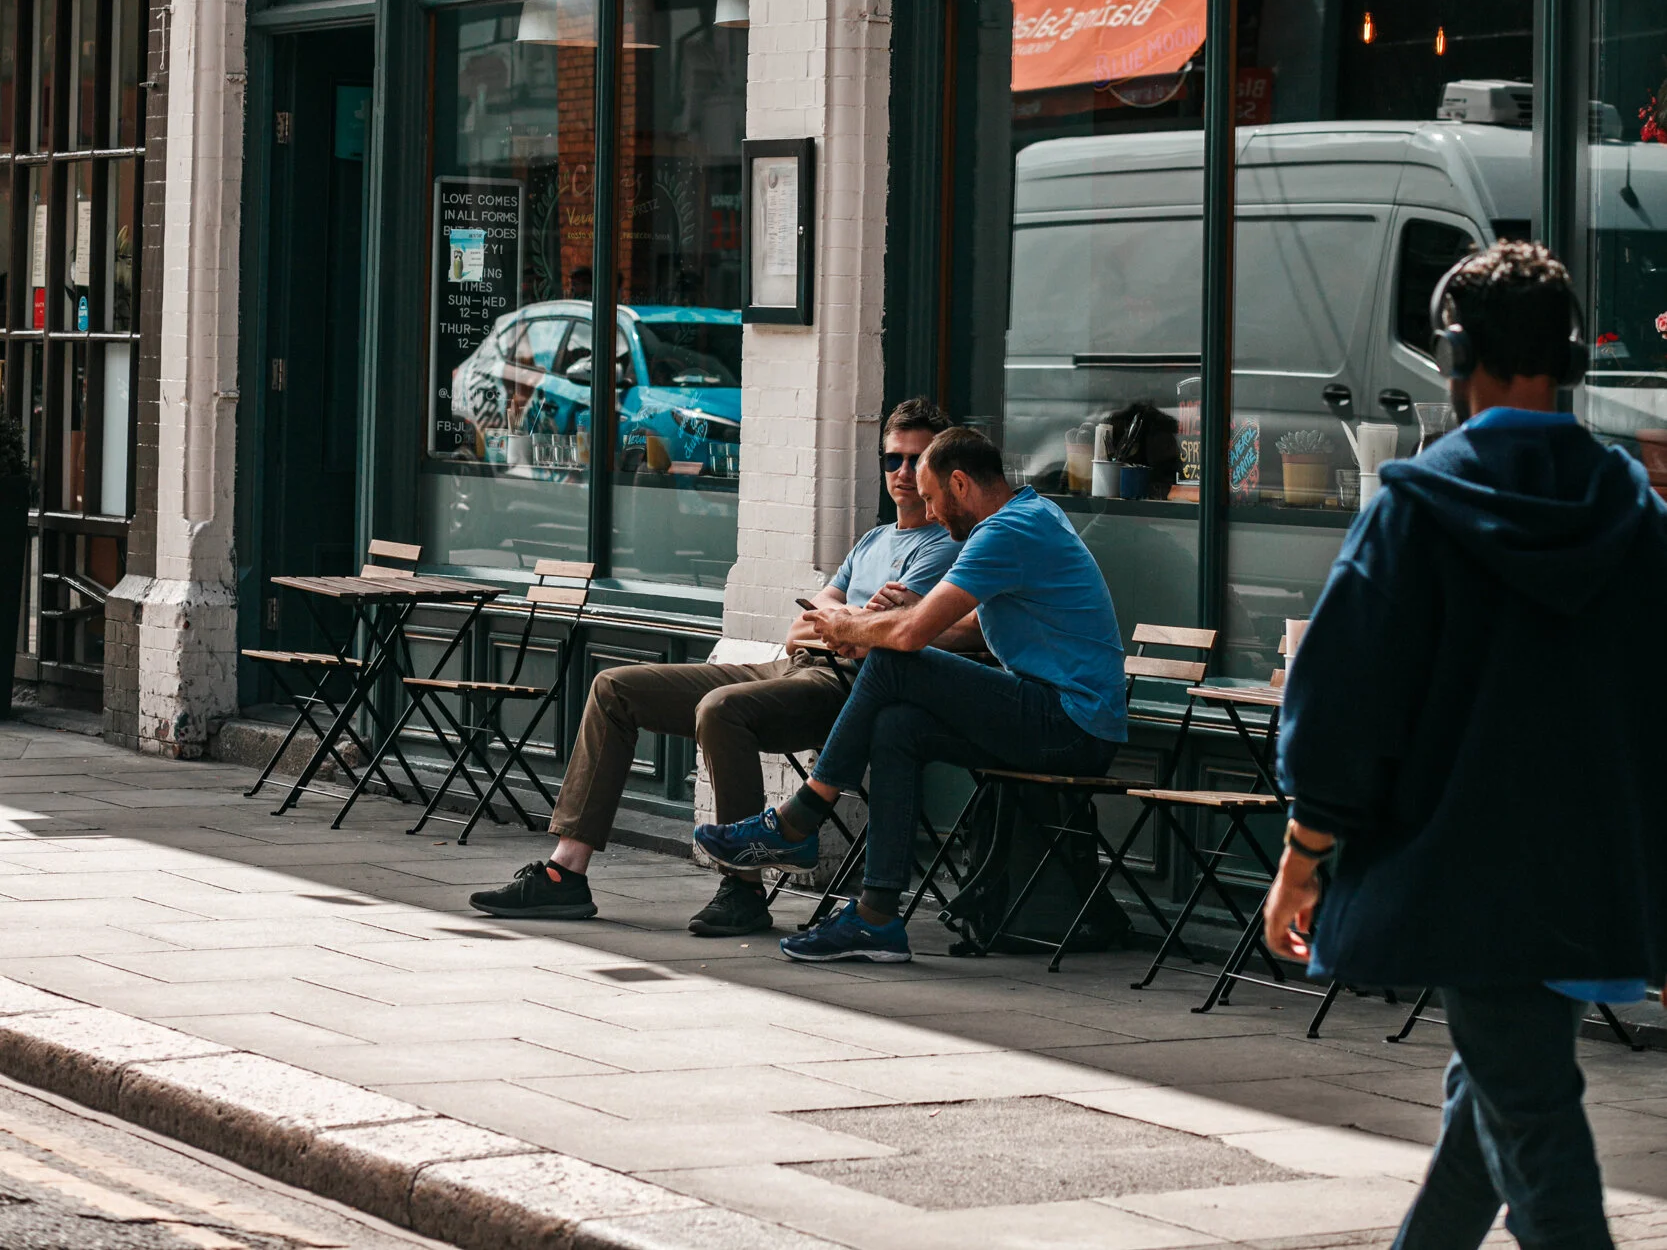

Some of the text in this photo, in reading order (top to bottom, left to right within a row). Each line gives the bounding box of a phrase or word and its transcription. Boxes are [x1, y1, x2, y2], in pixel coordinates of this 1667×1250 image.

[1094, 46, 1144, 87] BLUE
[1146, 25, 1199, 62] MOON
[442, 193, 518, 207] LOVE COMES
[444, 209, 456, 220] IN
[457, 209, 478, 221] ALL
[487, 227, 517, 239] DOES
